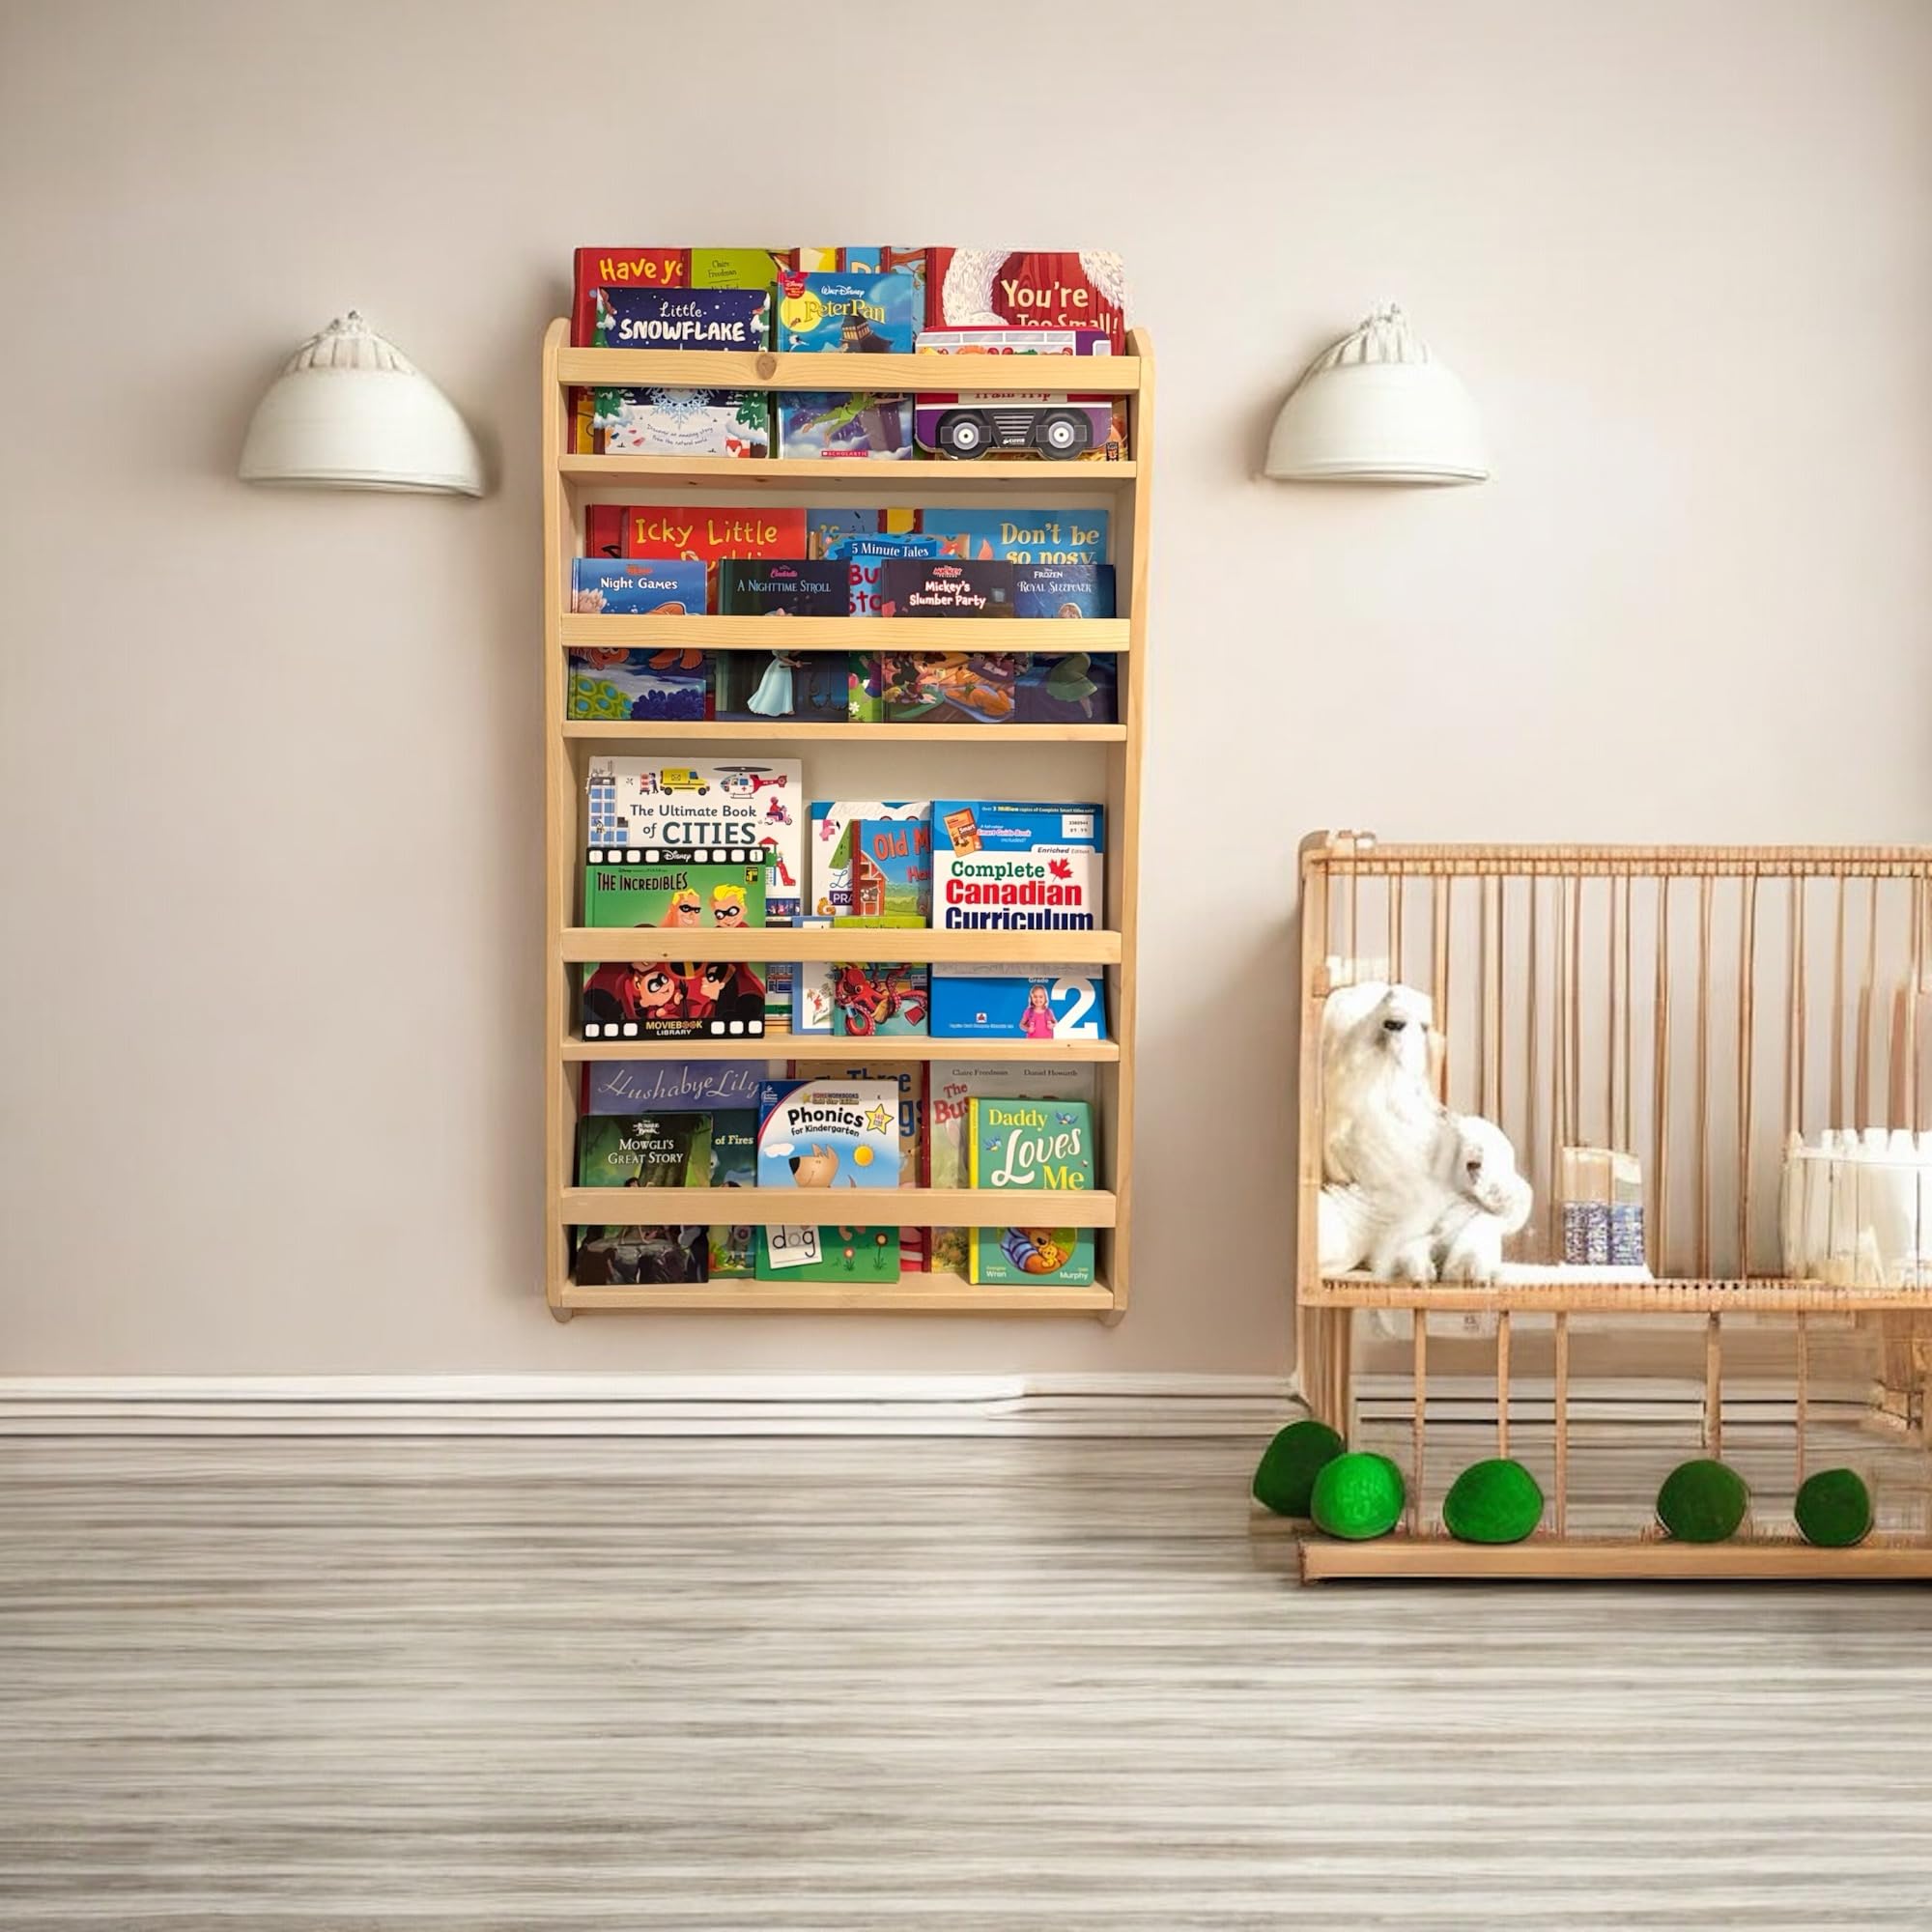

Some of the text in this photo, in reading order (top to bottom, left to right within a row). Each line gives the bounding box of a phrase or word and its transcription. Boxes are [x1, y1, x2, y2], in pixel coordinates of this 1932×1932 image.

[599, 258, 657, 282] Have
[1001, 278, 1089, 308] You're
[659, 301, 703, 318] Little
[804, 299, 886, 325] Peter Pan
[618, 319, 746, 342] SNOWFLAKE
[636, 518, 779, 549] Icky Little
[1001, 523, 1099, 547] Don't be
[851, 543, 929, 557] 5 Minute Tales
[1007, 551, 1032, 564] so
[601, 577, 678, 591] Night Games
[737, 580, 831, 594] A NIGHTTIME STROLL
[925, 580, 970, 595] Mickey's
[1016, 581, 1045, 593] ROYAL
[910, 593, 986, 610] Slumber Party
[630, 804, 757, 817] The Ultimate Book
[642, 821, 756, 844] of CITIES
[873, 829, 909, 861] Old
[597, 871, 688, 891] THE INCREDIBLES
[951, 861, 1045, 881] Complete
[945, 879, 1082, 905] Canadian
[945, 906, 1094, 930] Curriculum
[1051, 976, 1098, 1038] 2
[645, 1021, 703, 1030] MOVIEBOOK
[597, 1066, 759, 1100] Hushabye Lily
[943, 1083, 968, 1099] The
[787, 1106, 864, 1127] Phonics
[988, 1108, 1048, 1132] Daddy
[715, 1134, 754, 1146] of Fires
[791, 1124, 860, 1137] for Kindergarten
[619, 1138, 674, 1151] MOWGLI'S
[608, 1151, 684, 1164] GREAT STORY
[991, 1128, 1082, 1187] Loves
[1042, 1164, 1085, 1190] Me
[773, 1225, 815, 1258] dog
[1059, 1271, 1089, 1280] Murphy
